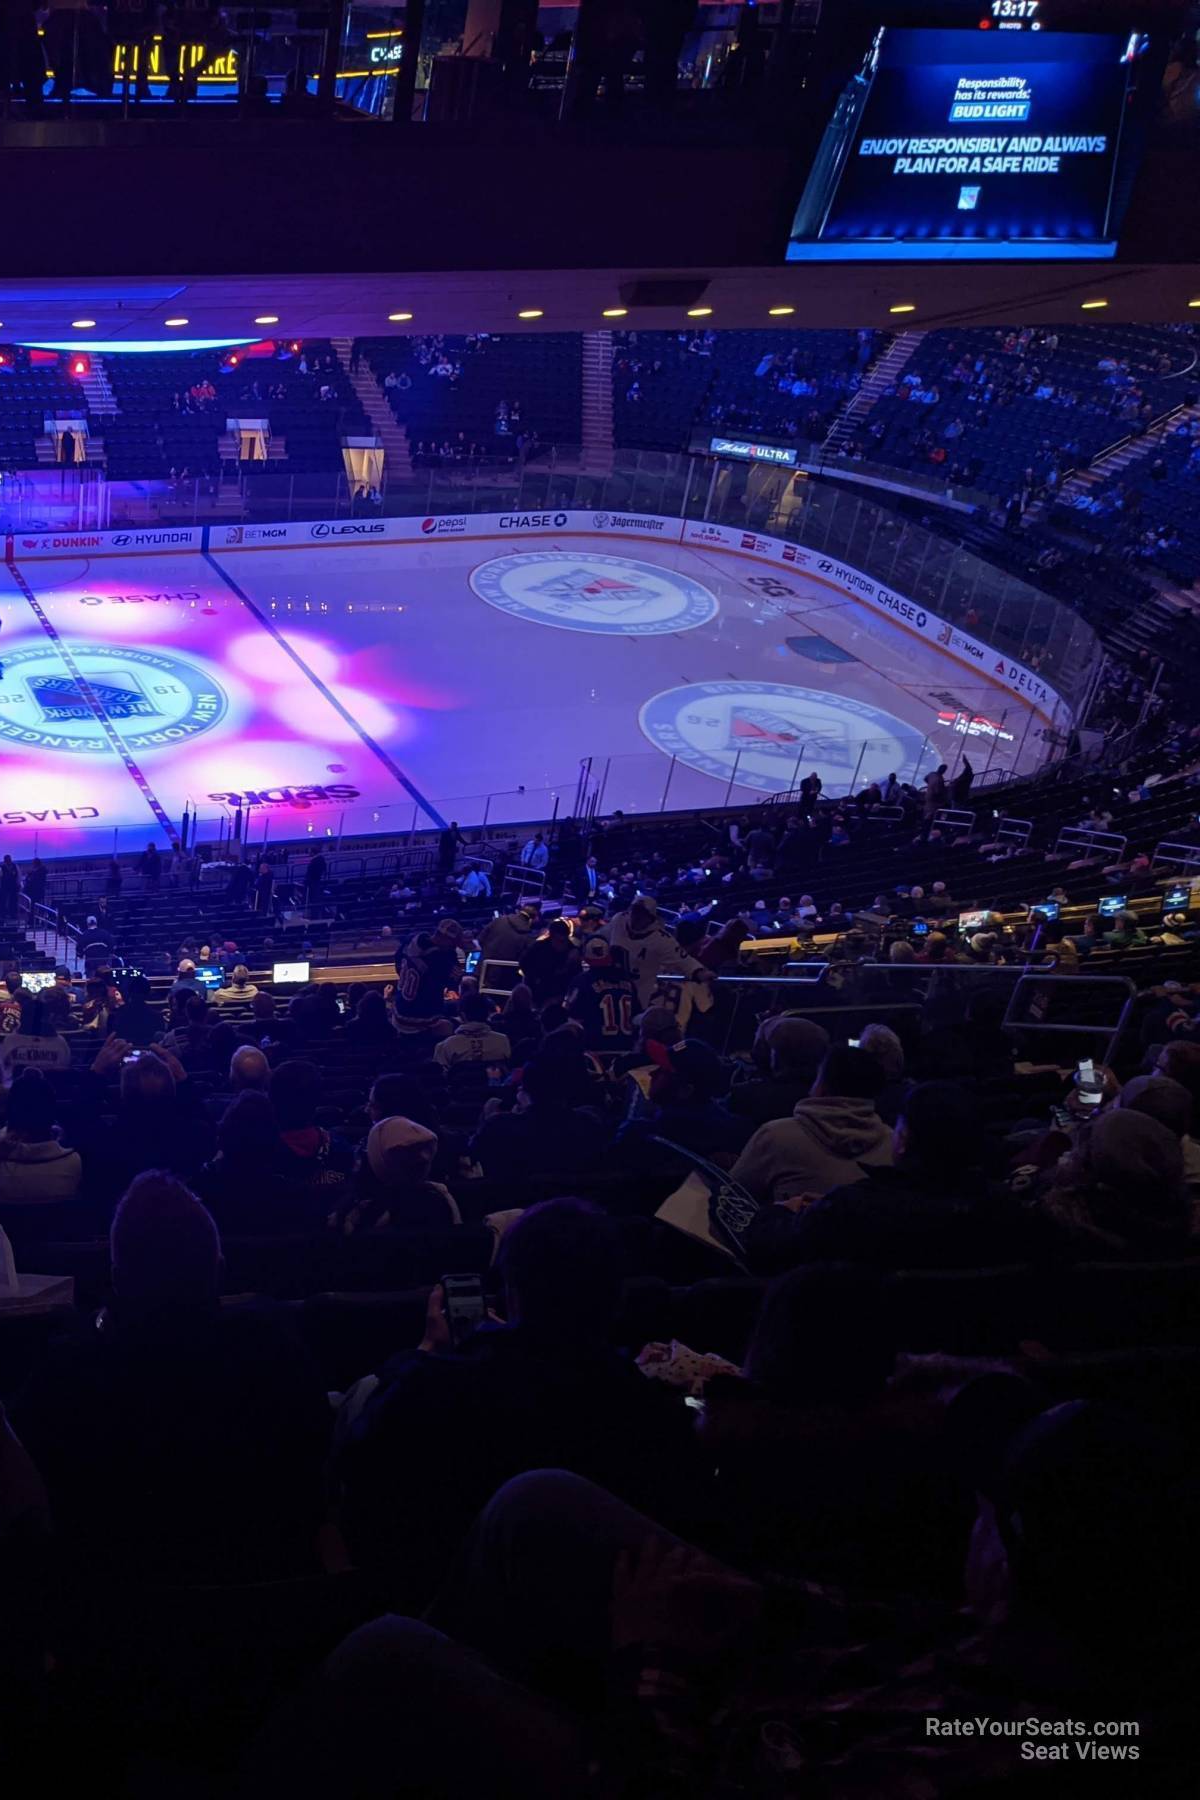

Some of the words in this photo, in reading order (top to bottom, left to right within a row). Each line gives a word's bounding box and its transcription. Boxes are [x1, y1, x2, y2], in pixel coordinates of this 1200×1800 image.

[991, 0, 1039, 17] 13:17
[957, 77, 1027, 90] Responsibility
[954, 90, 972, 100] has
[973, 90, 987, 100] its
[953, 105, 983, 118] BUD
[984, 105, 1027, 118] LIGHT
[859, 138, 906, 155] ENJOY
[907, 137, 1007, 154] RESPONSIBLY
[1007, 137, 1041, 152] AND
[1042, 136, 1106, 153] ALWAYS
[893, 157, 936, 174] PLAN
[936, 157, 967, 173] FOR
[968, 157, 981, 173] A
[982, 157, 1021, 173] SAFE
[1022, 156, 1059, 172] RIDE
[756, 447, 790, 461] ULTRA
[438, 516, 467, 530] pepsi
[499, 515, 551, 529] CHASE
[244, 527, 287, 540] BETMGM
[330, 523, 385, 536] LEXUS
[134, 531, 193, 545] HYUNDAI
[835, 565, 875, 596] HYUNDAI
[108, 592, 201, 604] CHASE
[877, 588, 915, 622] CHASE
[951, 634, 984, 661] BETMGM
[98, 648, 175, 669] MADISON
[153, 684, 180, 696] 19
[1009, 665, 1048, 703] DELTA
[45, 707, 99, 719] YORK
[109, 703, 151, 715] NEW
[191, 693, 218, 723] NEW
[128, 722, 200, 748] YORK
